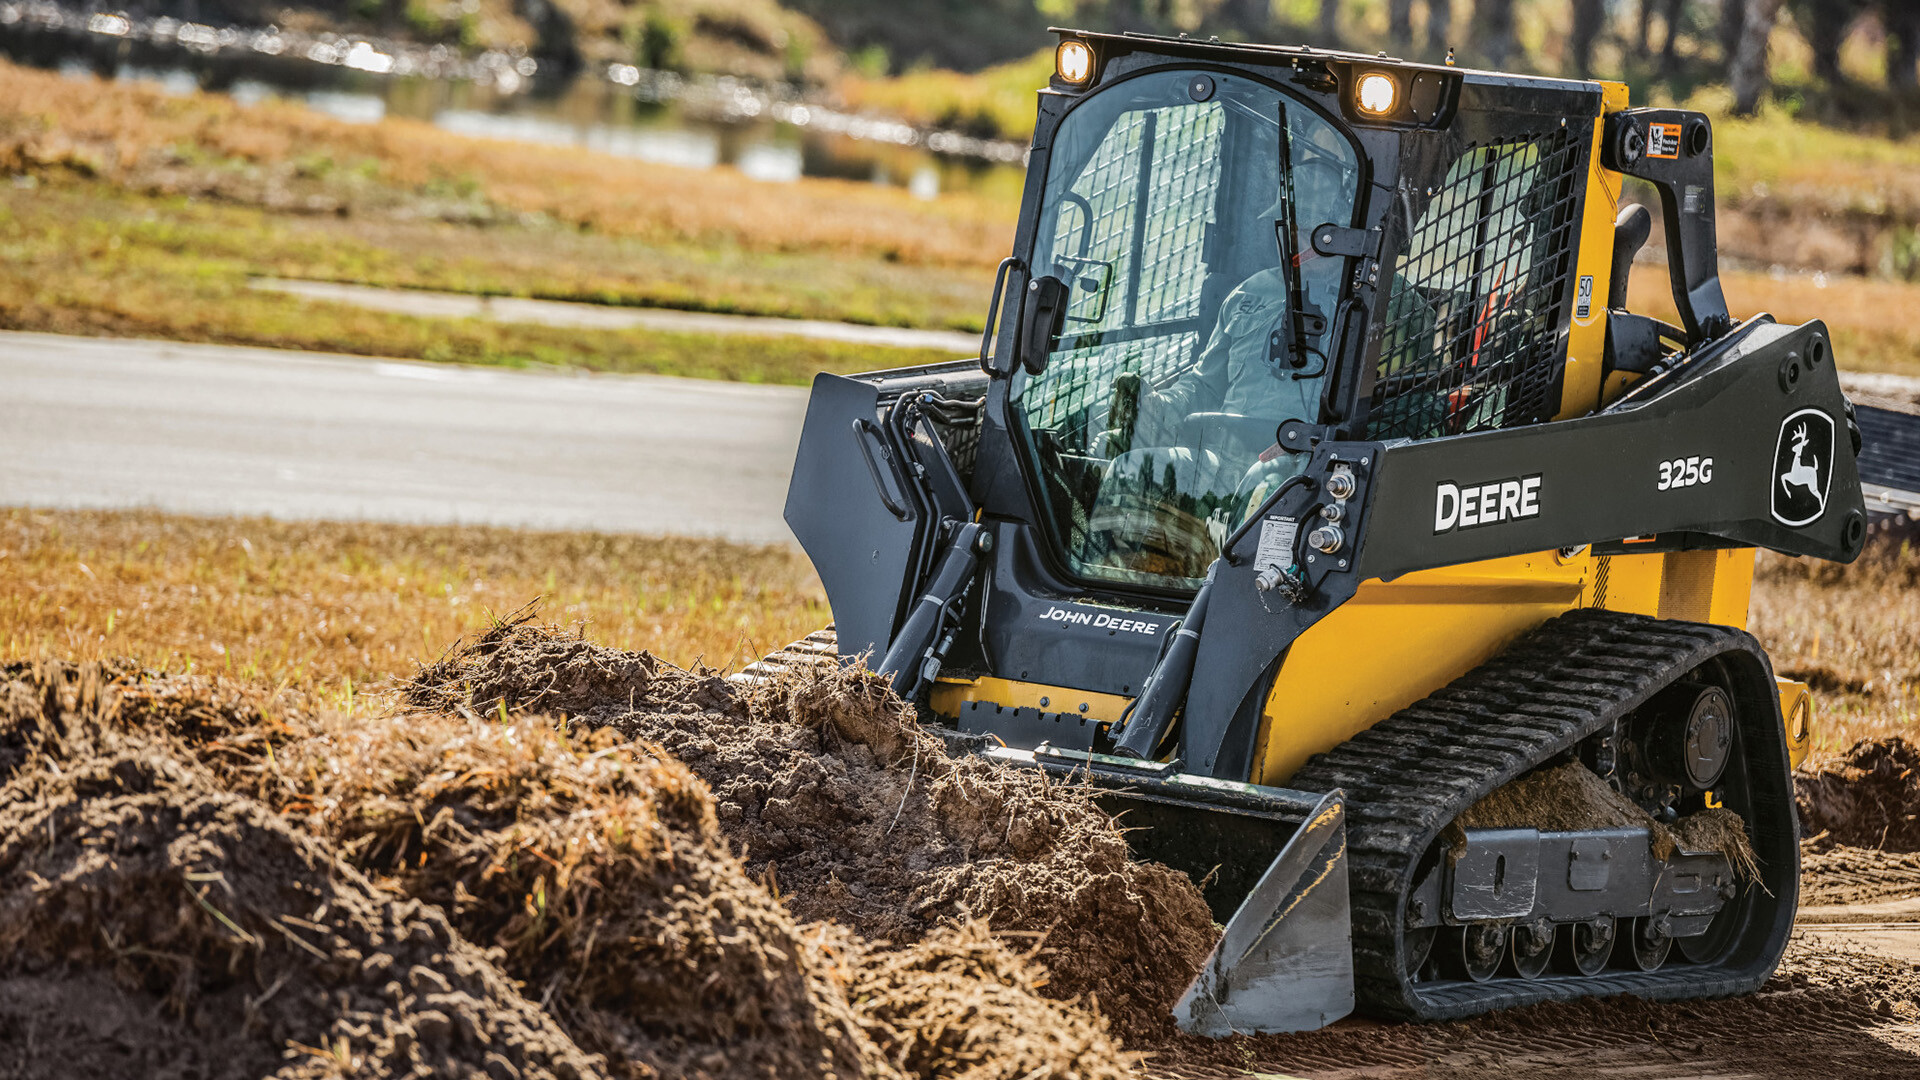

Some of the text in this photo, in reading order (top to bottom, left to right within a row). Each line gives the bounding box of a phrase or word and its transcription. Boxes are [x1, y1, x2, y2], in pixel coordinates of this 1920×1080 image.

[1579, 278, 1592, 297] 50
[1658, 456, 1713, 491] 325G
[1435, 476, 1541, 531] DEERE
[1039, 606, 1159, 635] JOHN DEERE
